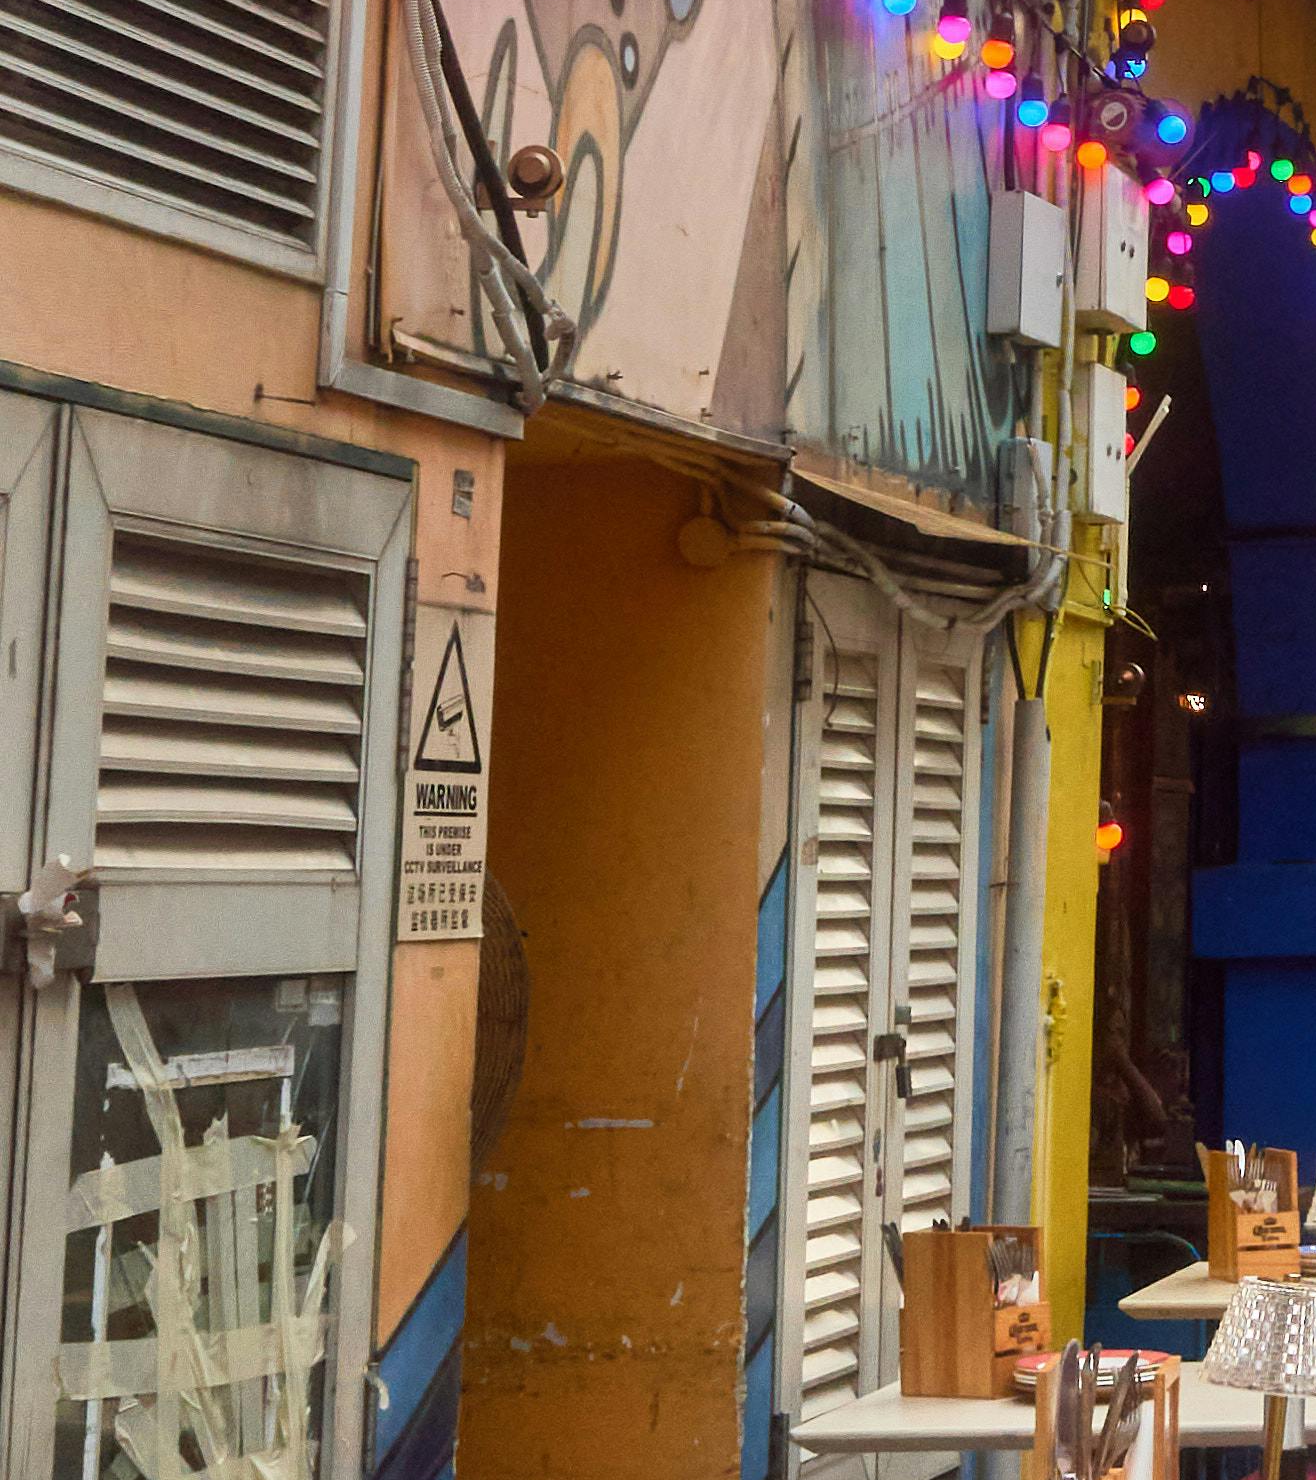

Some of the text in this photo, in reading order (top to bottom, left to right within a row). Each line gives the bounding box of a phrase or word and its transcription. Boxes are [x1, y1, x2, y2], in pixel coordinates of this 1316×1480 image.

[415, 783, 478, 811] WARNING
[419, 825, 472, 839] THIS PREMISE
[426, 843, 462, 857] IS UNDER
[404, 861, 483, 874] CCTV SURVEILLANCE
